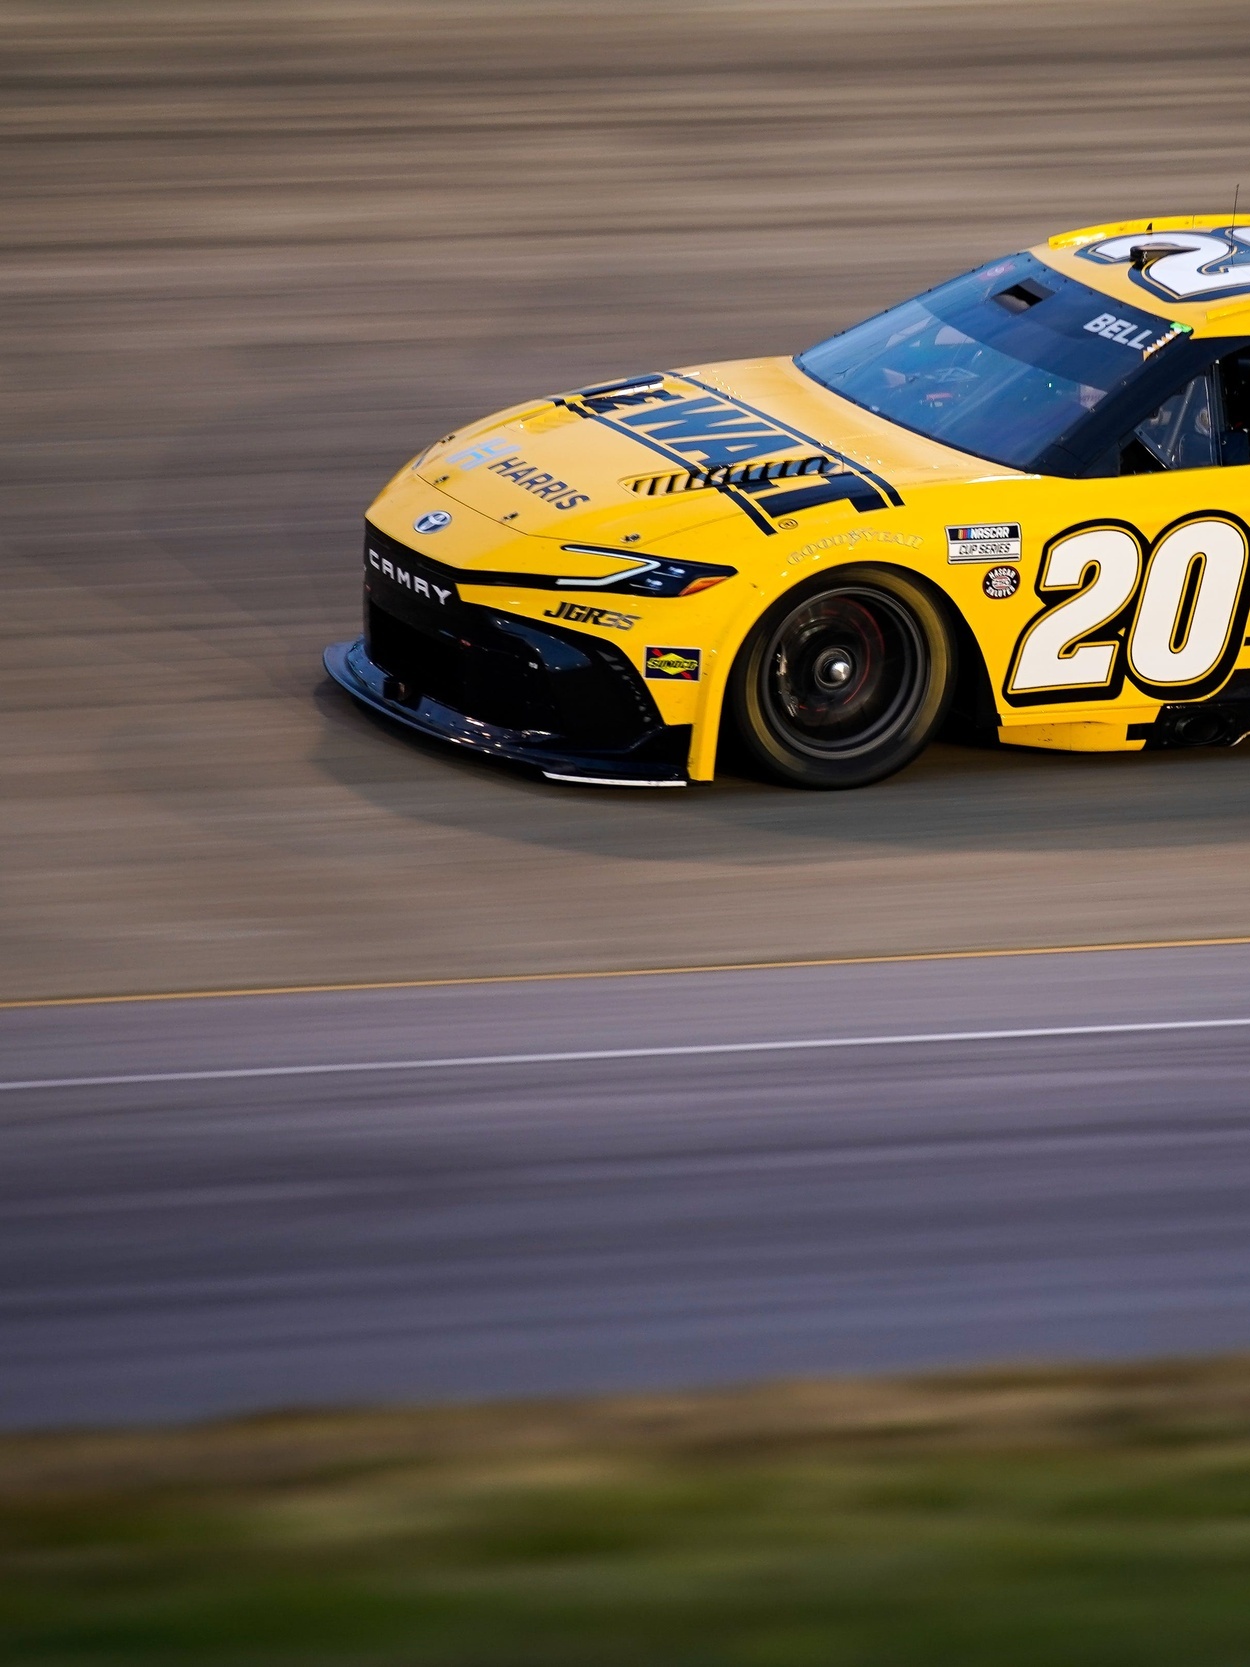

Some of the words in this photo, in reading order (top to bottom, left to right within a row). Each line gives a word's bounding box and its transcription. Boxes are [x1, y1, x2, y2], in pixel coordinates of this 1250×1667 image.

[1083, 312, 1153, 350] BELL
[572, 374, 890, 518] EWALT
[488, 457, 590, 510] HARRIS
[787, 527, 924, 566] GOODYEAR
[959, 545, 978, 555] CUP
[979, 543, 1011, 554] SERIES
[970, 527, 1010, 540] NASCAR
[369, 548, 452, 606] CAMRY
[988, 567, 1016, 580] NASCAR
[1012, 519, 1249, 693] 20
